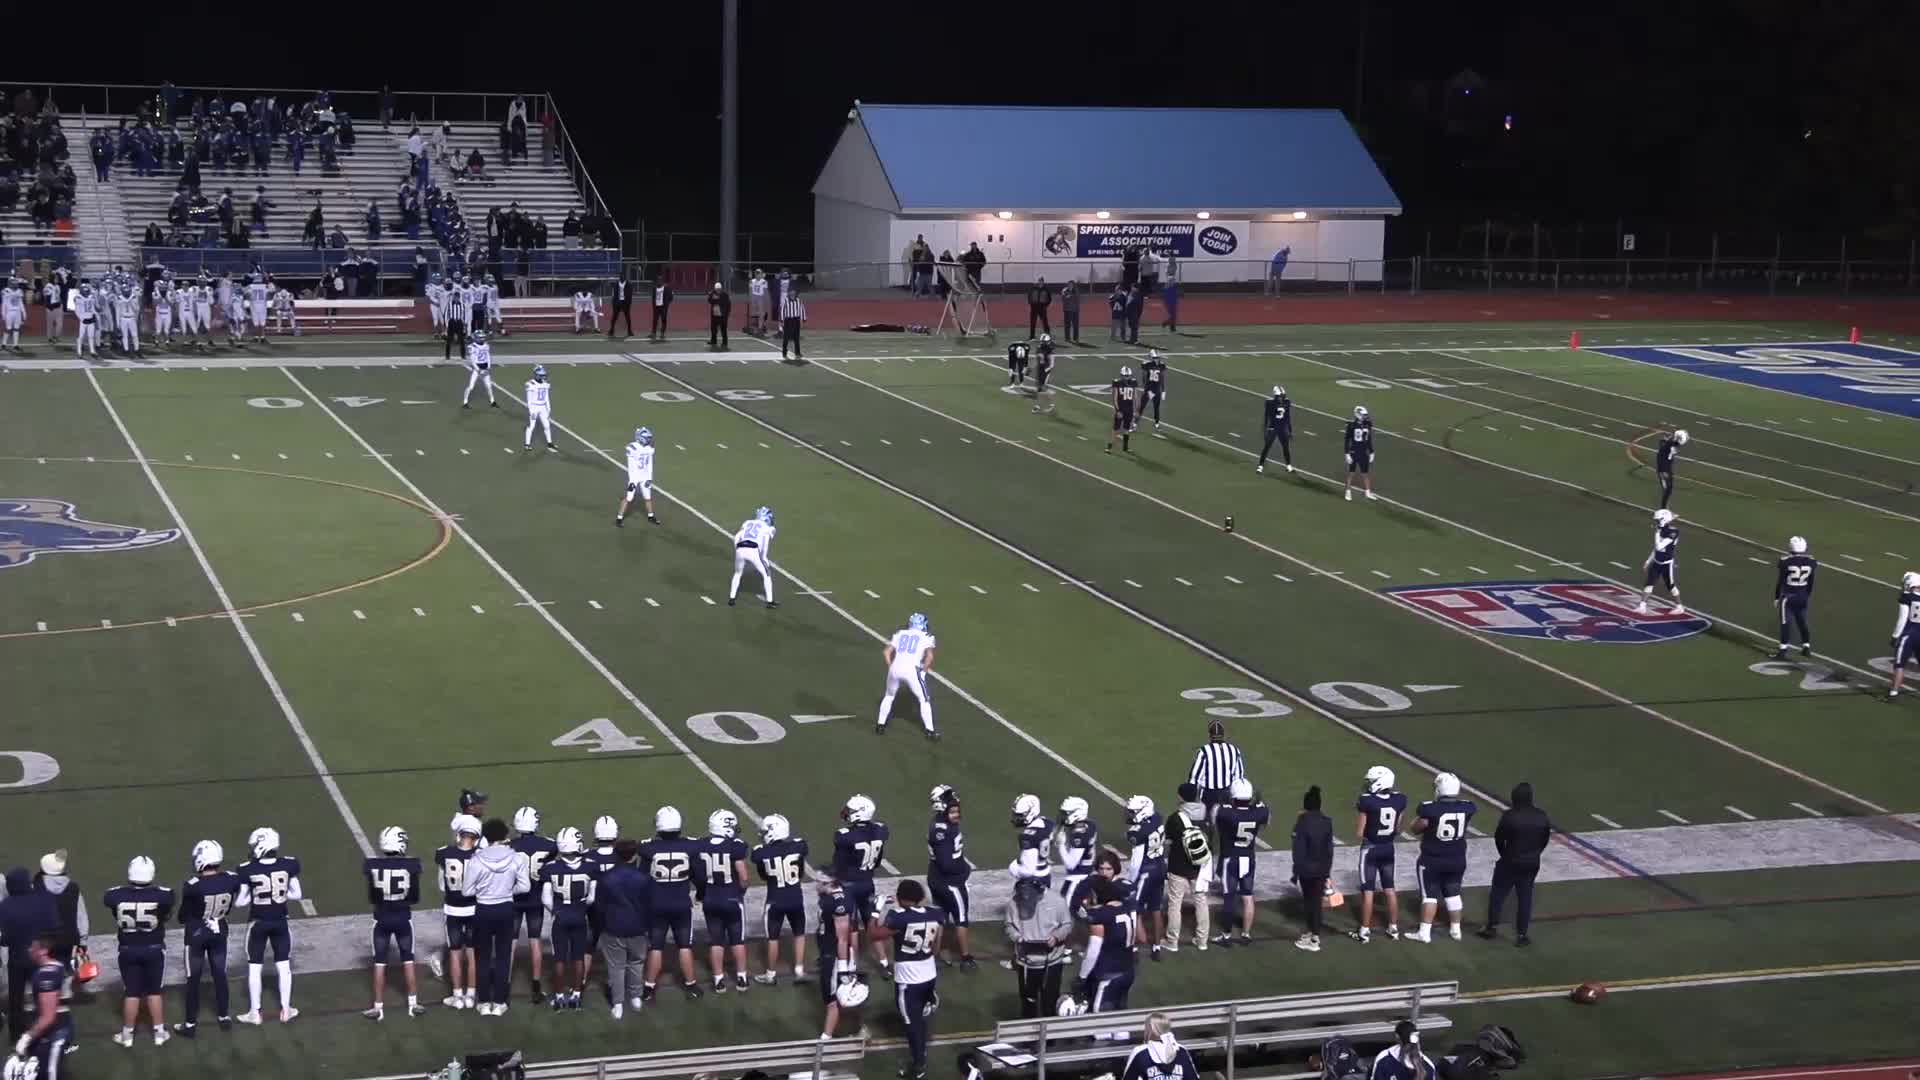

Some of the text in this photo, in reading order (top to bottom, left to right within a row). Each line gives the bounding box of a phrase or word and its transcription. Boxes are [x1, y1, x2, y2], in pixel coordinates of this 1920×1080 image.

[1079, 225, 1193, 235] SPRING-FORD ALUMNI
[1100, 236, 1172, 246] ASSOCIATION
[1202, 236, 1233, 252] TODAY
[1207, 229, 1232, 242] JOIN
[1275, 407, 1286, 419] 3
[1786, 566, 1812, 587] 22
[1234, 821, 1257, 848] 5
[1377, 806, 1397, 836] 9
[1435, 812, 1466, 842] 61
[650, 852, 689, 883] 62
[762, 853, 800, 888] 46
[249, 870, 289, 905] 28
[370, 868, 410, 901] 43
[116, 902, 158, 933] 65
